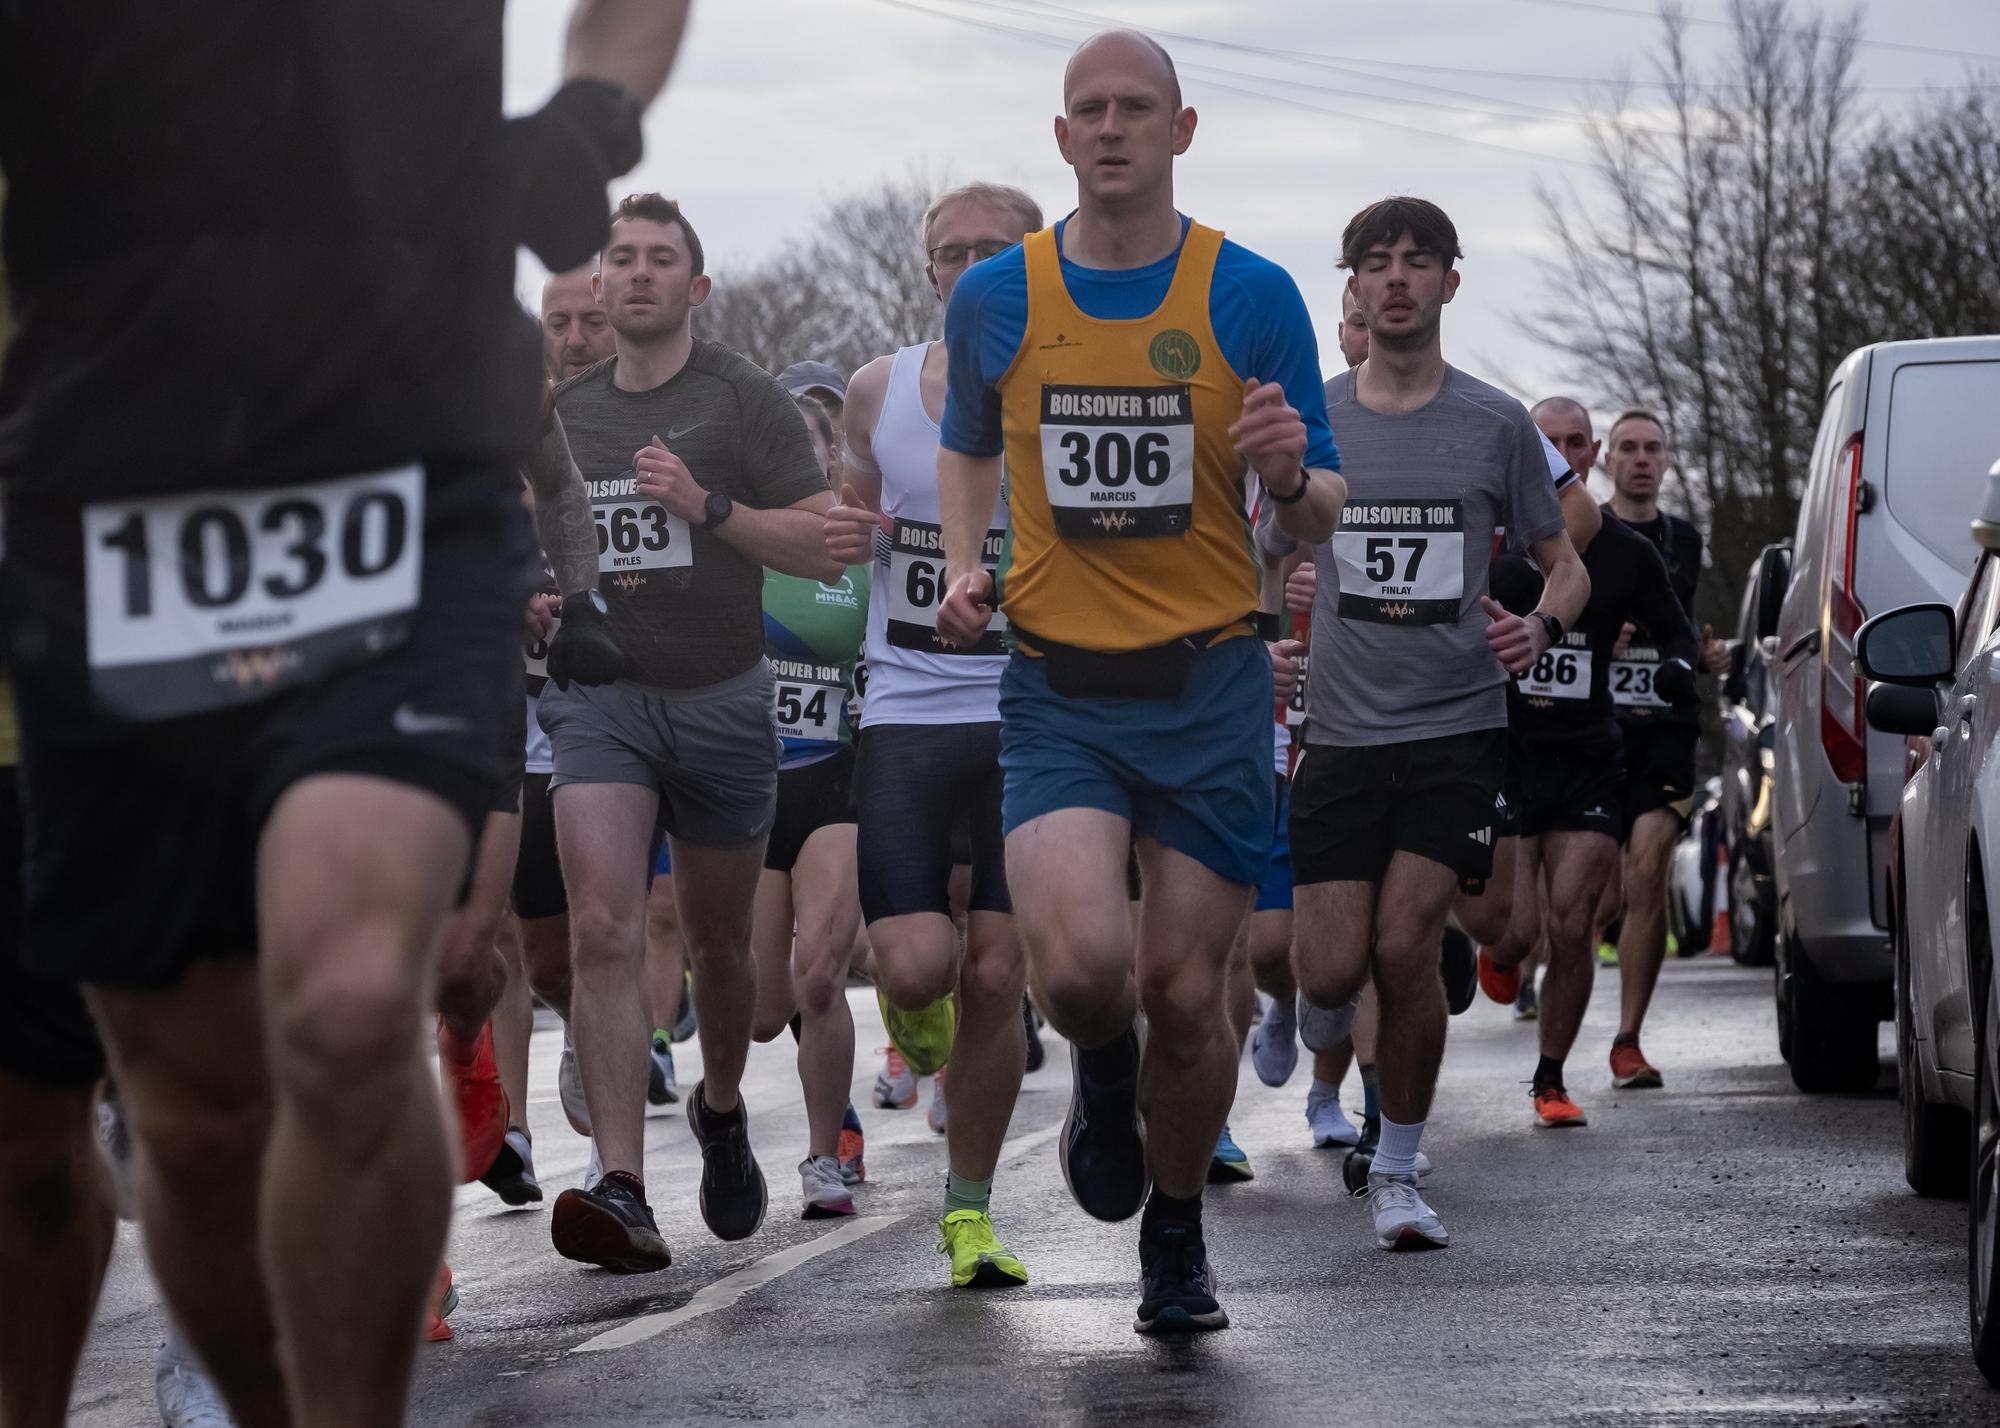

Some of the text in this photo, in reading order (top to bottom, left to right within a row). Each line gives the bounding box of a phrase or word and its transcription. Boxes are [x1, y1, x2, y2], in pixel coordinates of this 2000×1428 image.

[1050, 394, 1181, 417] BOLSOVER 10K
[1059, 431, 1171, 488] 306
[584, 479, 638, 498] OLSOVE
[1090, 492, 1136, 502] MARCUS
[1342, 506, 1455, 525] BOLSOVER 10K
[900, 526, 1003, 555] BOLS 10
[102, 491, 407, 617] 1030
[613, 556, 642, 567] MYLES
[1365, 538, 1428, 583] 57
[816, 592, 858, 606] MH&AC
[1381, 586, 1413, 595] FINLAY
[1567, 632, 1587, 647] 10K
[770, 659, 813, 677] SOVER
[816, 665, 841, 682] 10K
[1517, 652, 1578, 684] 86
